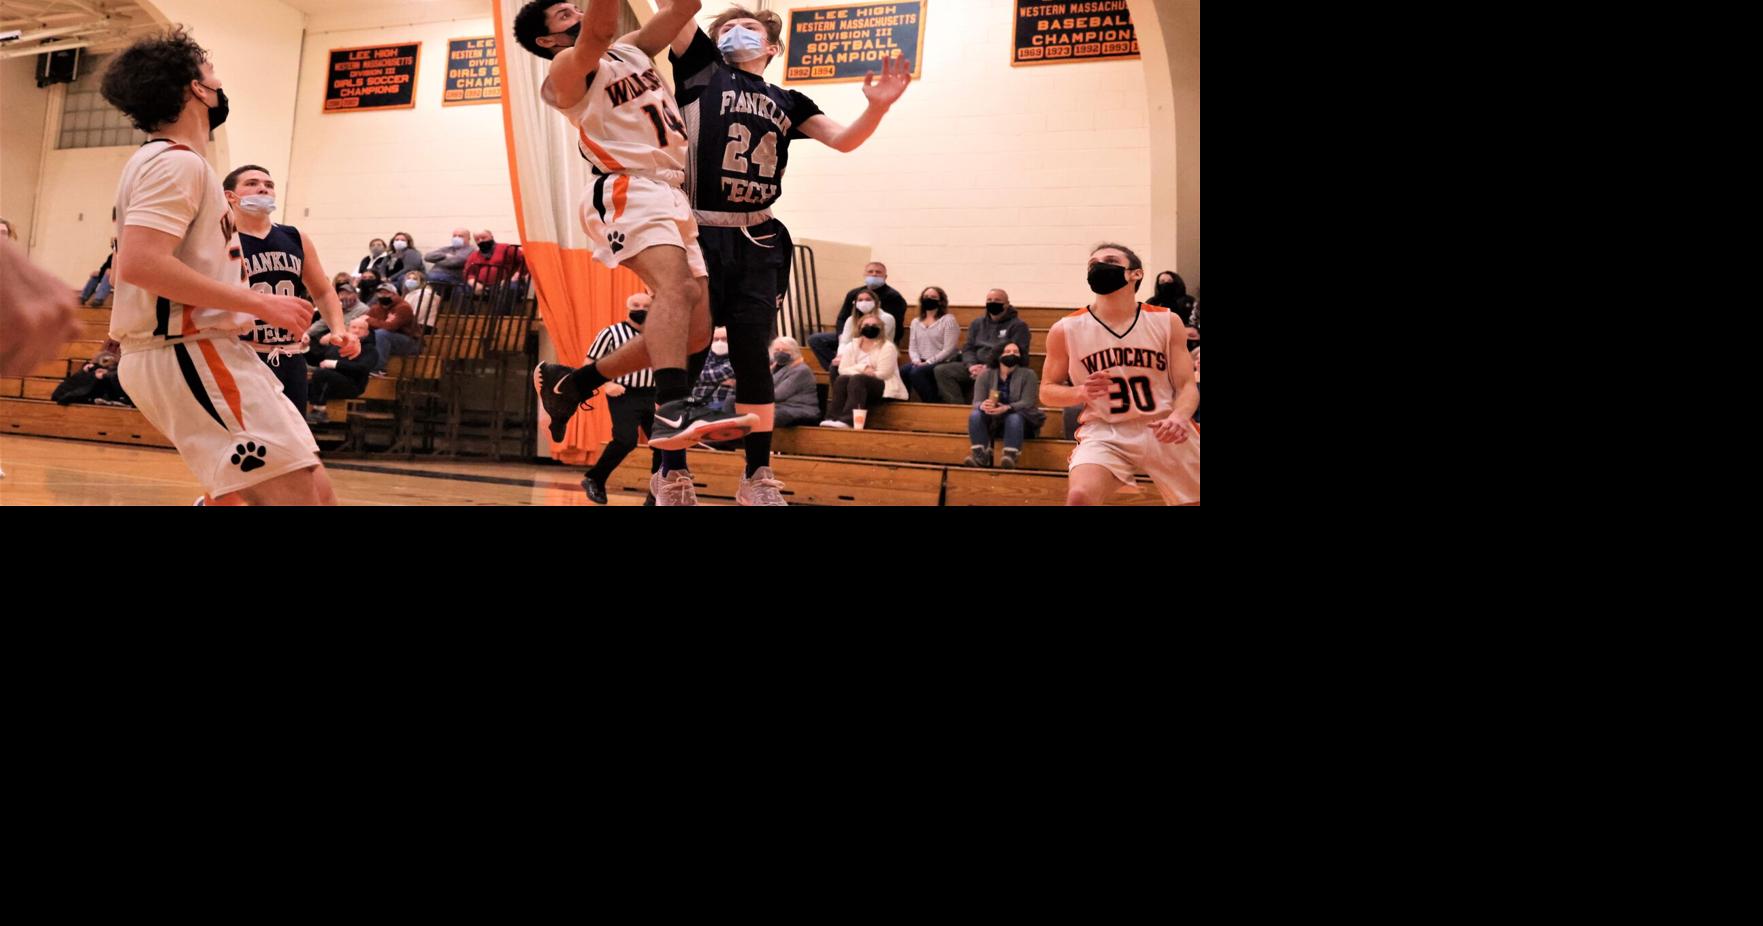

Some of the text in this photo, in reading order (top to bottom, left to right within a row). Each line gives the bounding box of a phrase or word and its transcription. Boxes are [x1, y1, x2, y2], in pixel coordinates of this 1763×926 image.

[815, 6, 897, 20] LEE HIGH
[1020, 0, 1129, 17] WESTERN MASSACHU
[796, 14, 916, 33] WESTERN MASSACHUSETTS
[815, 28, 893, 41] DIVISION III
[467, 40, 494, 49] LEE
[807, 38, 898, 53] SOFTBALL
[349, 48, 398, 60] LEE HIGH
[802, 48, 902, 65] CHAMPIONS
[450, 67, 487, 78] GIRLS
[789, 67, 809, 77] 1992
[334, 74, 409, 88] GIRLS SOCCER
[340, 84, 400, 97] CHAMPIONS
[722, 122, 778, 178] 24
[1081, 347, 1168, 375] WILDCATS
[1109, 376, 1156, 414] 30
